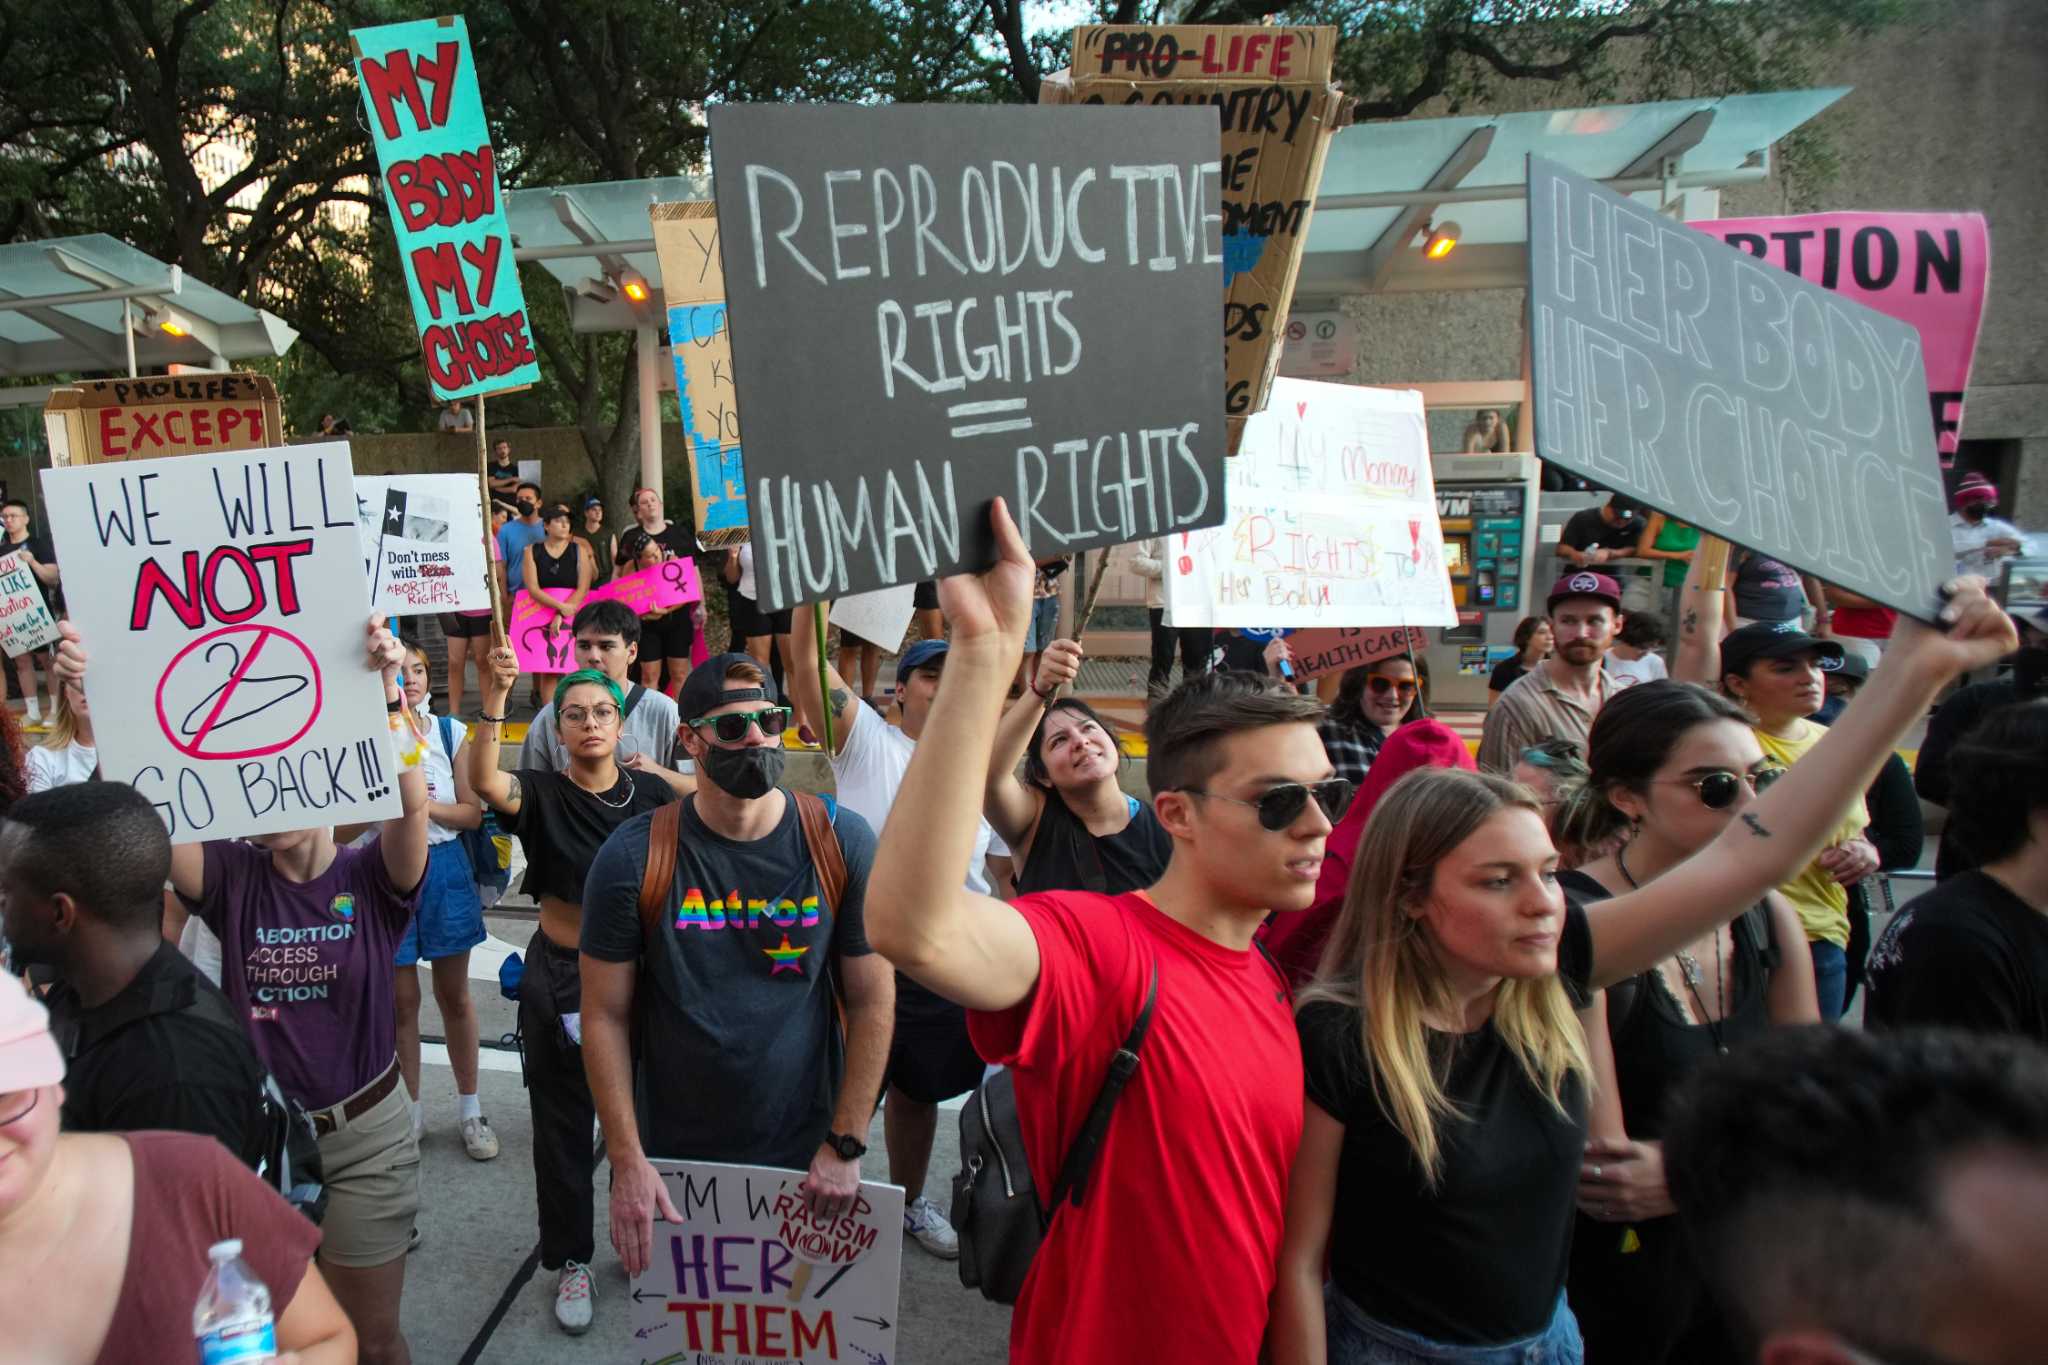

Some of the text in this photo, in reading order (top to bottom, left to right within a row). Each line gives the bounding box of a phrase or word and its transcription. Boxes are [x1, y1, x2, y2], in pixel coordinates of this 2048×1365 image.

[360, 41, 459, 141] MY
[386, 144, 495, 233] BODY
[745, 160, 1224, 289] REPRODUCTIVE
[411, 235, 502, 320] MY
[422, 310, 537, 392] CHOICE
[877, 289, 1083, 399] RIGHTS
[1551, 175, 1921, 458] HER BODY
[100, 407, 263, 456] EXCEPT
[1540, 303, 1945, 607] HER CHOICE
[89, 457, 356, 547] WE WILL
[757, 423, 1210, 609] HUMAN RIGHTS
[130, 538, 314, 631] NOT
[387, 550, 450, 564] Don't mess
[391, 565, 417, 579] with
[132, 766, 215, 838] GO
[256, 923, 356, 945] ABORTION
[675, 886, 820, 931] Astros
[246, 964, 337, 985] THROUGH
[248, 946, 319, 965] ACCESS
[773, 1193, 879, 1251] RACISM
[670, 1235, 795, 1299] HER
[667, 1302, 838, 1361] THEM
